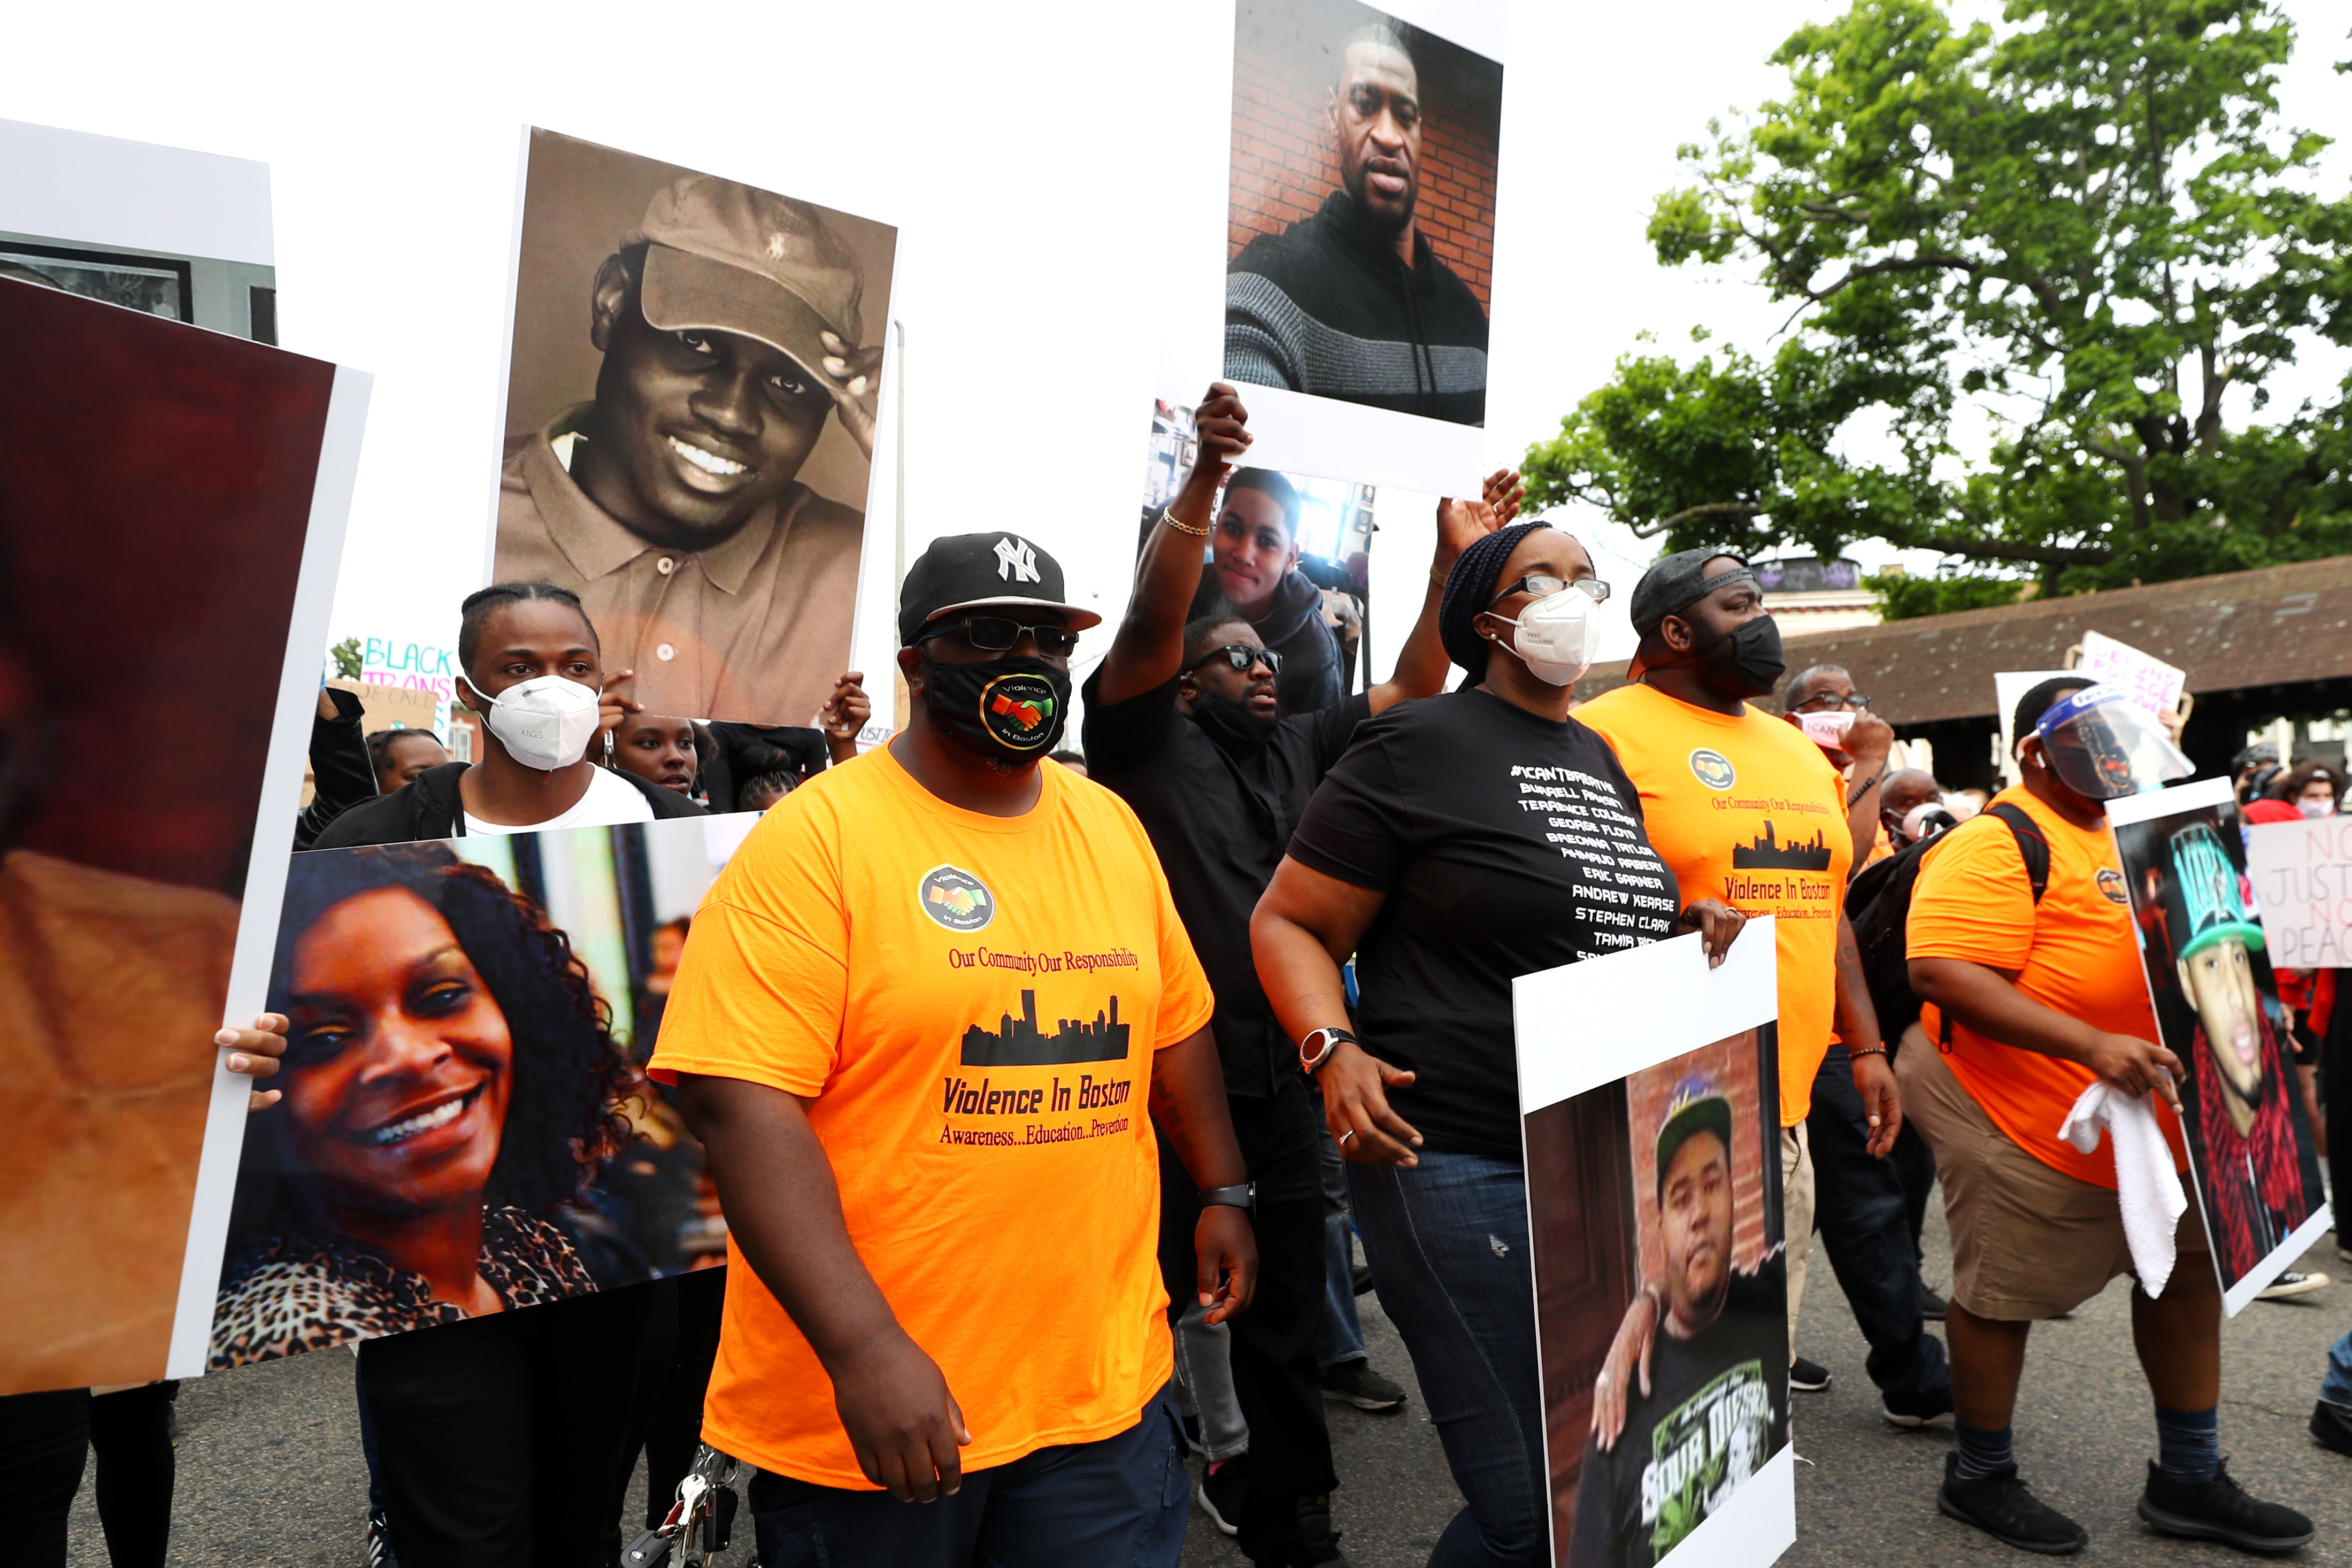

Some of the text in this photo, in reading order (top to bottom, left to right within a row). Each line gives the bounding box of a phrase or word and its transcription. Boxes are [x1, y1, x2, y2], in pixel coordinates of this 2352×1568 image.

[993, 536, 1041, 584] NY
[364, 637, 453, 677] BLACK
[388, 688, 432, 709] CALL
[1002, 685, 1047, 695] Violence
[520, 729, 543, 739] KN95
[1002, 728, 1044, 742] In Boston
[1510, 765, 1617, 795] #ICANTBREATHE
[1519, 782, 1581, 799] BURRELL
[1517, 800, 1638, 828] TERRENCE COLEMAN
[1711, 797, 1727, 810] Our
[1727, 796, 1770, 812] Community
[1770, 797, 1785, 810] Our
[1548, 817, 1637, 840] GEORGE FLOYD
[1545, 833, 1657, 858] BREONNA TAYLOR
[1560, 847, 1665, 873] AHMAUD ARBERY
[933, 873, 974, 886] Violence
[1582, 866, 1665, 891] ERIC GARNER
[1724, 876, 1831, 900] Violence In Boston
[1572, 884, 1675, 912] ANDREW KEARSE
[953, 916, 983, 925] Boston
[1574, 907, 1671, 934] STEPHEN CLARK
[1593, 931, 1634, 948] TAMIR
[949, 947, 1139, 977] Our Community Our Responsibility
[943, 1074, 1131, 1114] Violence In Boston
